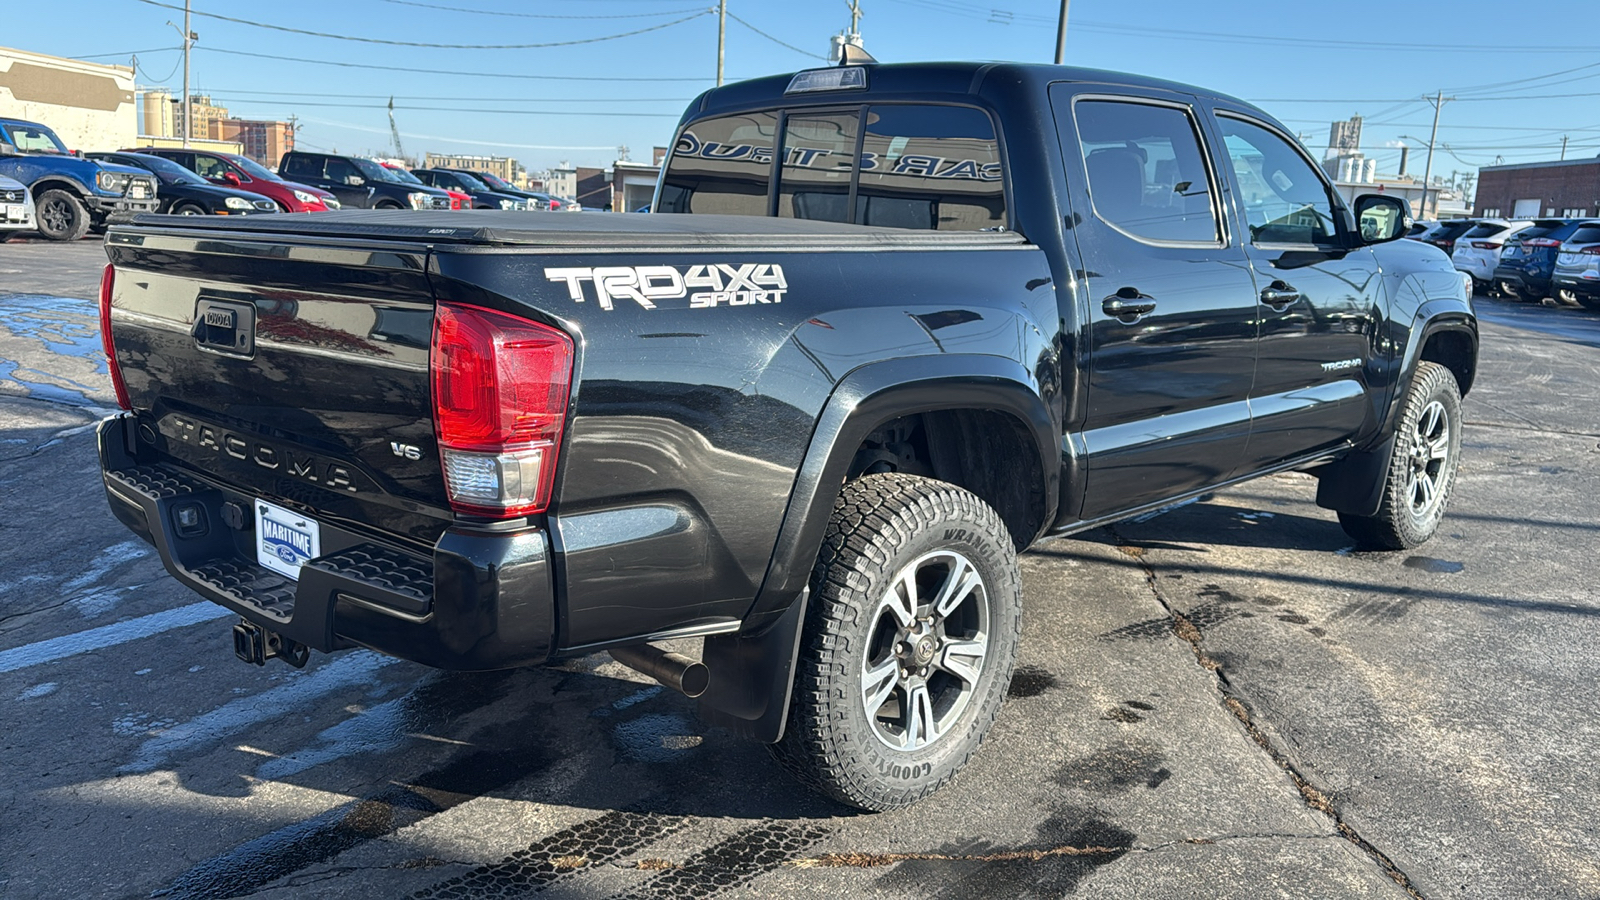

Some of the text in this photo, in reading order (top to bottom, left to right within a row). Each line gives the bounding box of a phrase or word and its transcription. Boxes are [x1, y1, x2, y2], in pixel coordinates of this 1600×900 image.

[544, 264, 788, 310] TRD 4X4
[690, 289, 787, 308] SPORT
[207, 312, 231, 327] TOYOTA
[1320, 358, 1362, 373] TACOMA
[173, 416, 357, 492] TACOMA
[390, 441, 426, 461] V6
[263, 519, 311, 558] MARITIME
[943, 528, 1006, 582] WRANGLER
[857, 730, 932, 780] GOODYEAR
